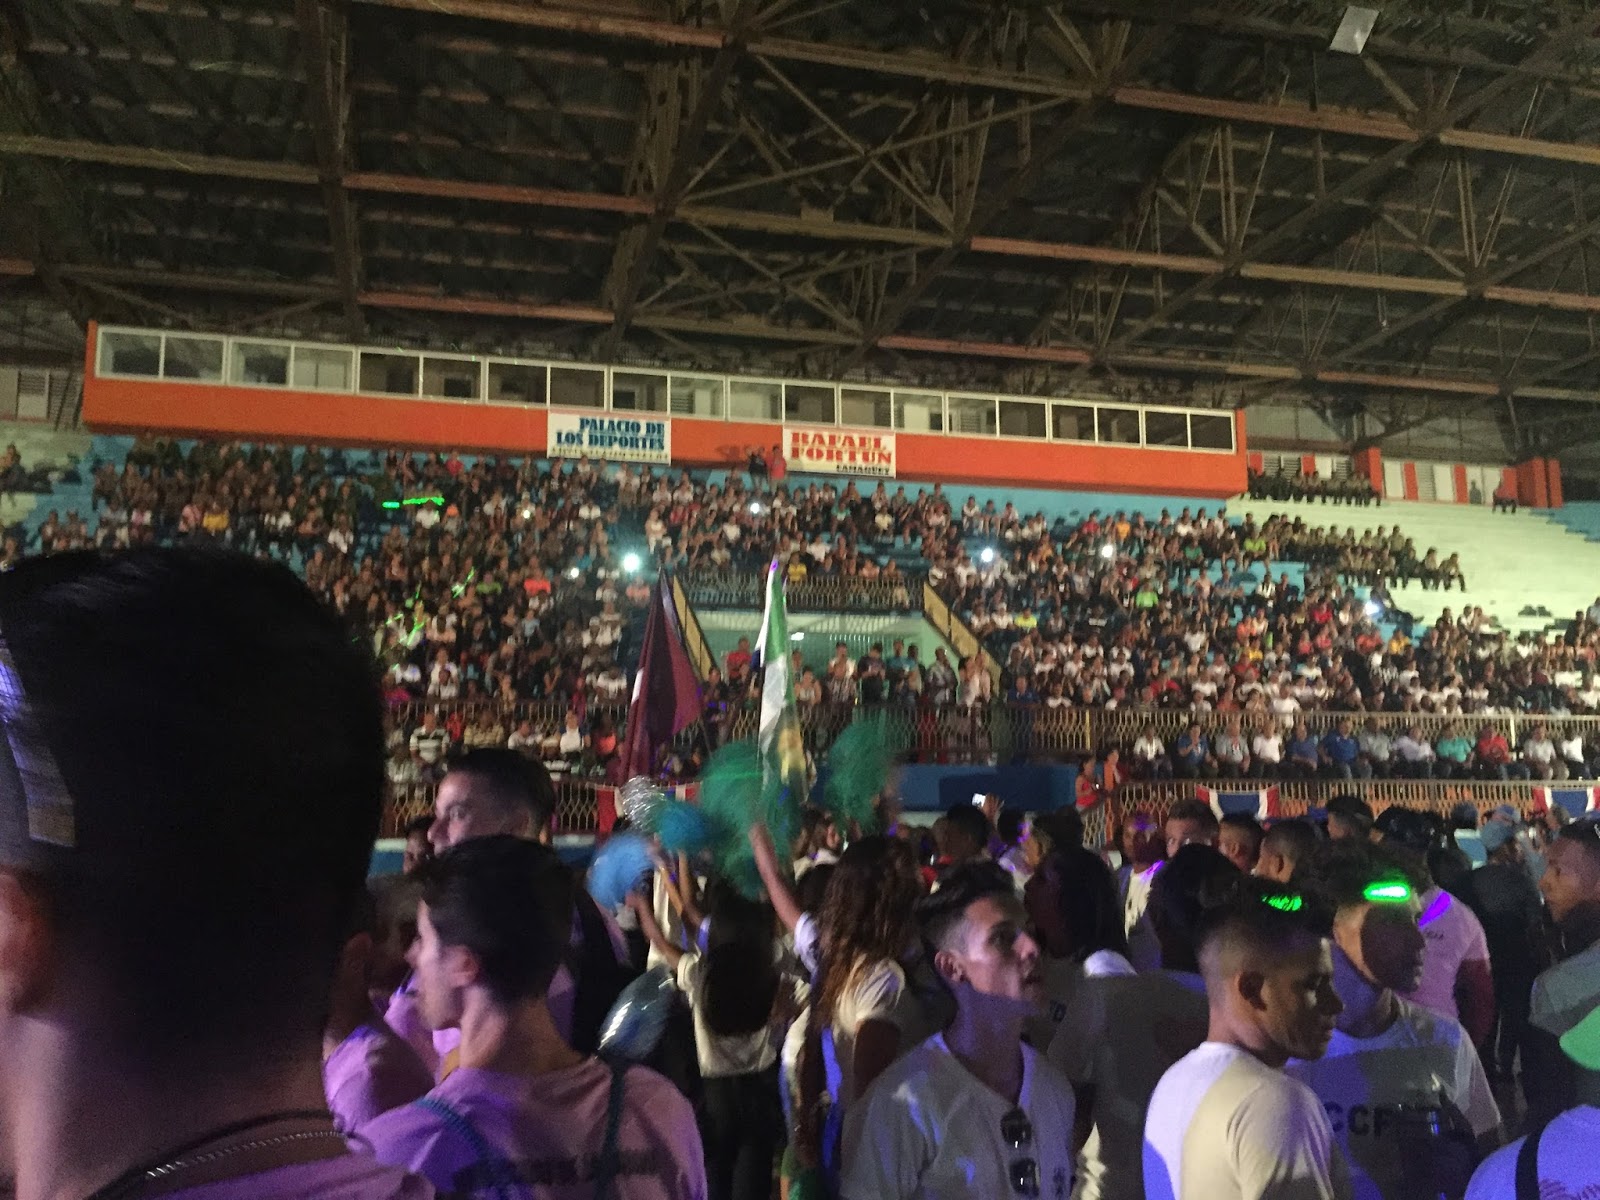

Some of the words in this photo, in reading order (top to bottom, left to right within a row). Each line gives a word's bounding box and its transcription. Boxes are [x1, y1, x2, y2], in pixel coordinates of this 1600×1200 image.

[579, 417, 641, 433] PALACIO
[645, 422, 665, 435] DE
[556, 431, 583, 446] LOS
[588, 434, 665, 450] DEPORTES
[792, 431, 882, 449] RAFAEL
